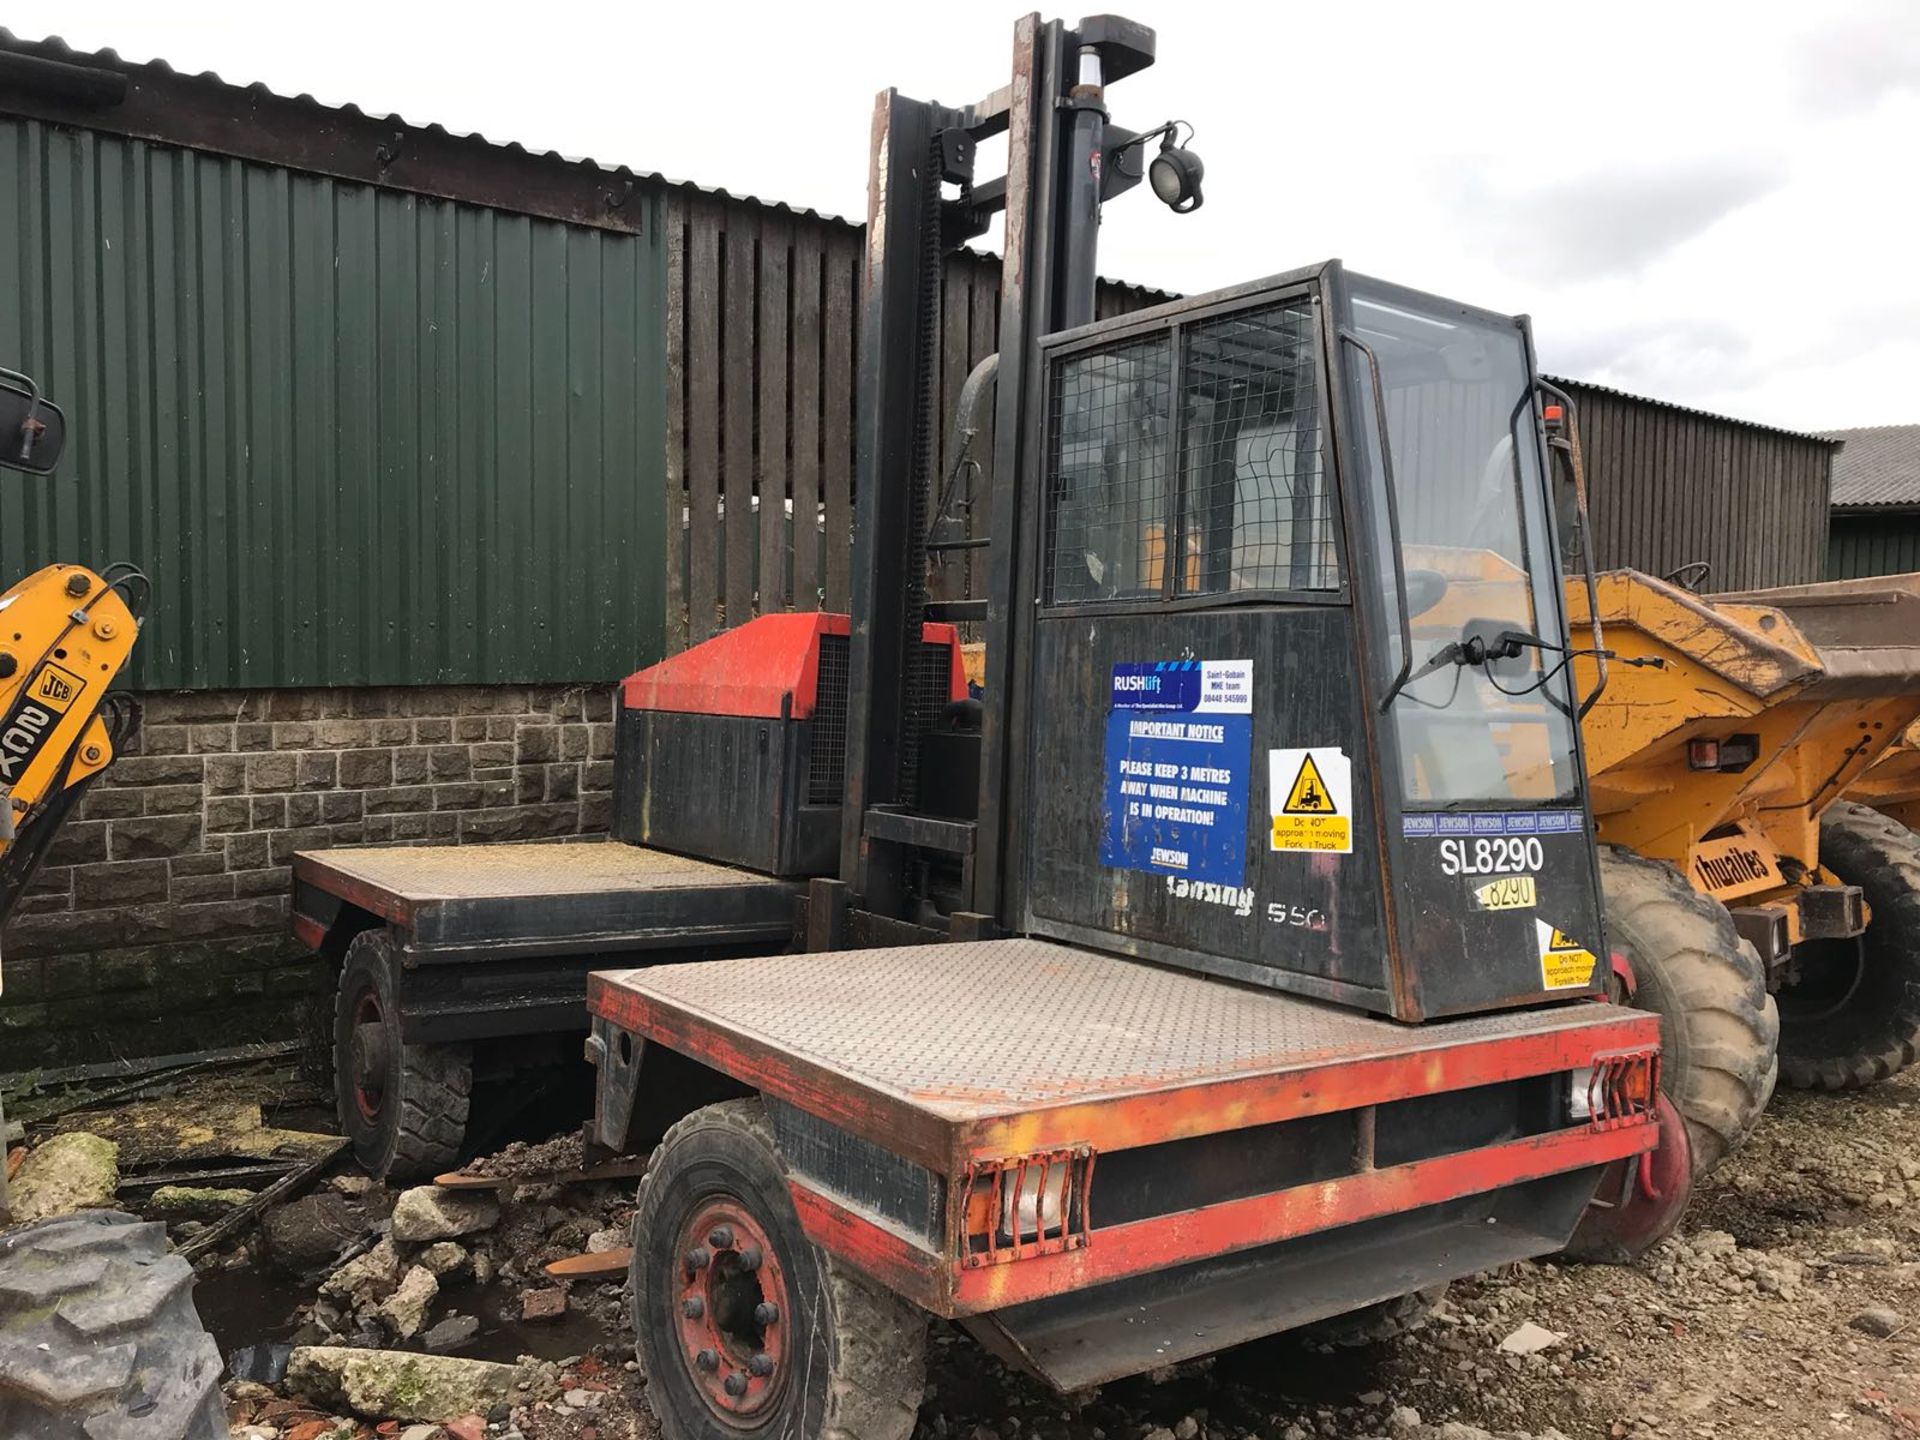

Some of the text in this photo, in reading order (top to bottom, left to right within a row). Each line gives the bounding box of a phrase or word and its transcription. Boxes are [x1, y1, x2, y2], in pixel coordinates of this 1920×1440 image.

[1114, 675, 1161, 694] RUSHlift
[1207, 670, 1246, 679] Saint-Gobain
[42, 674, 71, 700] JCB
[1130, 720, 1224, 741] IMPORTANT NOTICE
[1120, 760, 1231, 784] PLEASE KEEP 3 METRES
[1120, 780, 1228, 806] AWAY WHEN MACHINE
[1130, 802, 1214, 826] IS IN OPERATION!
[1403, 817, 1434, 829] JEWSON
[1438, 816, 1469, 828] JEWSON
[1474, 816, 1503, 828] JEWSON
[1507, 816, 1534, 828] JEWSON
[1538, 815, 1565, 827] JEWSON
[1314, 841, 1337, 850] Truck
[1151, 847, 1189, 866] JEWSON
[1440, 837, 1544, 876] SL8290
